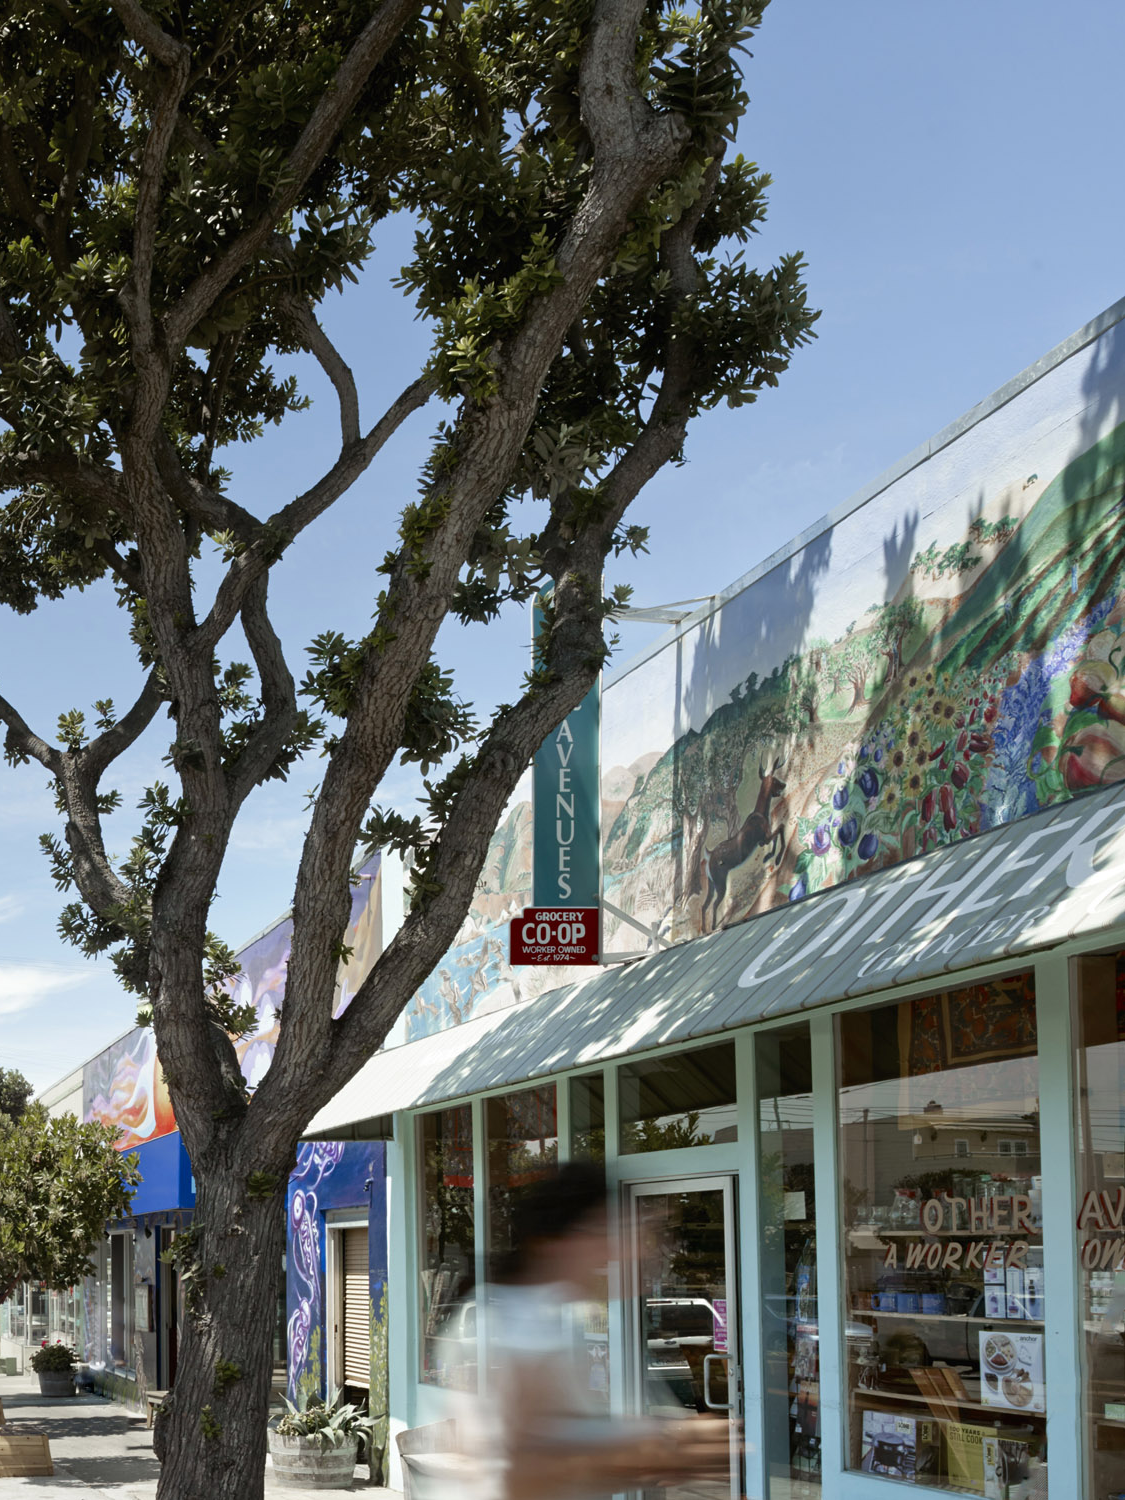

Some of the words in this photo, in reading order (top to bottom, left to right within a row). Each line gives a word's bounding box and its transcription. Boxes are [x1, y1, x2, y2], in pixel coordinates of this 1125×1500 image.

[555, 719, 575, 899] AVENUES
[737, 799, 1125, 988] OTHER
[535, 911, 584, 921] GROCERY
[920, 1192, 1038, 1235] OTHER
[883, 1241, 897, 1269] A
[905, 1240, 1030, 1271] WORKER
[949, 1432, 964, 1442] STILL
[961, 1427, 980, 1435] YEARS
